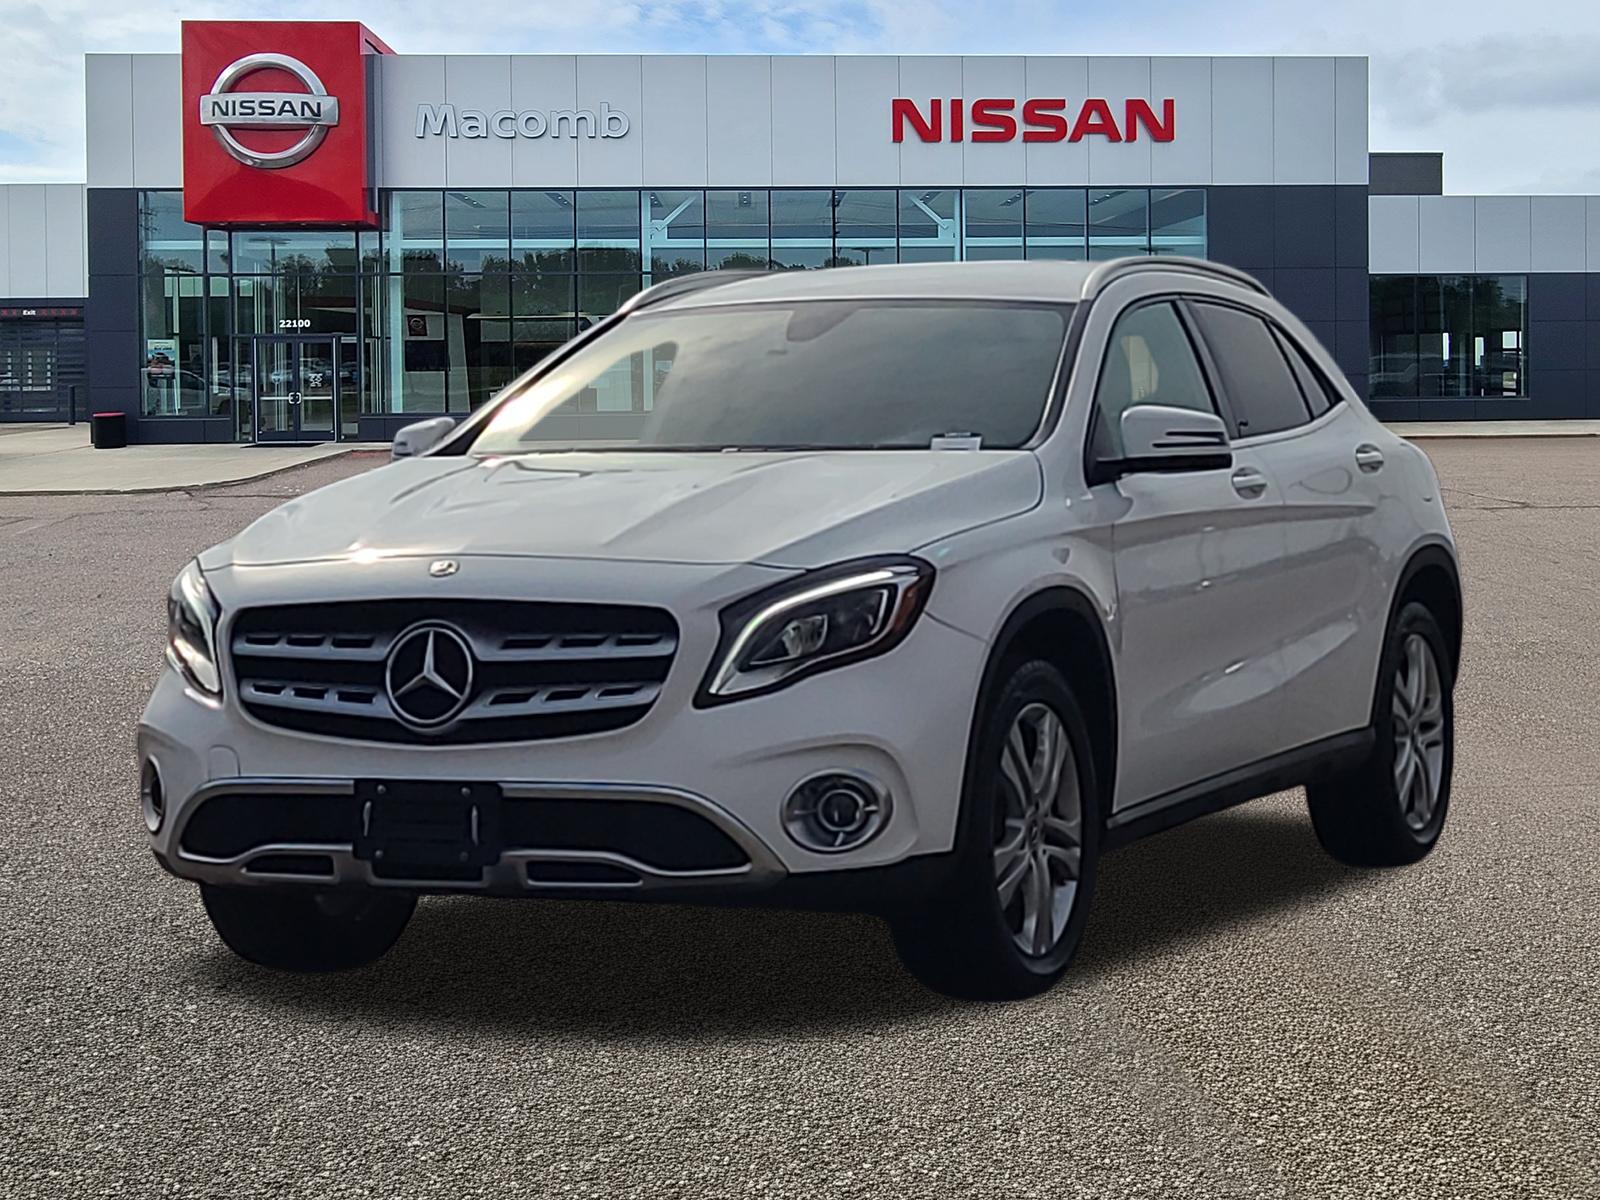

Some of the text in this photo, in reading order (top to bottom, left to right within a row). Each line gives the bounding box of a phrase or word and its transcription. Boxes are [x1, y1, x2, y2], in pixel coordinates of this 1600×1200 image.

[212, 100, 322, 117] NISSAN
[415, 102, 629, 138] Macomb
[892, 99, 1174, 142] NISSAN
[279, 319, 311, 328] 22100
